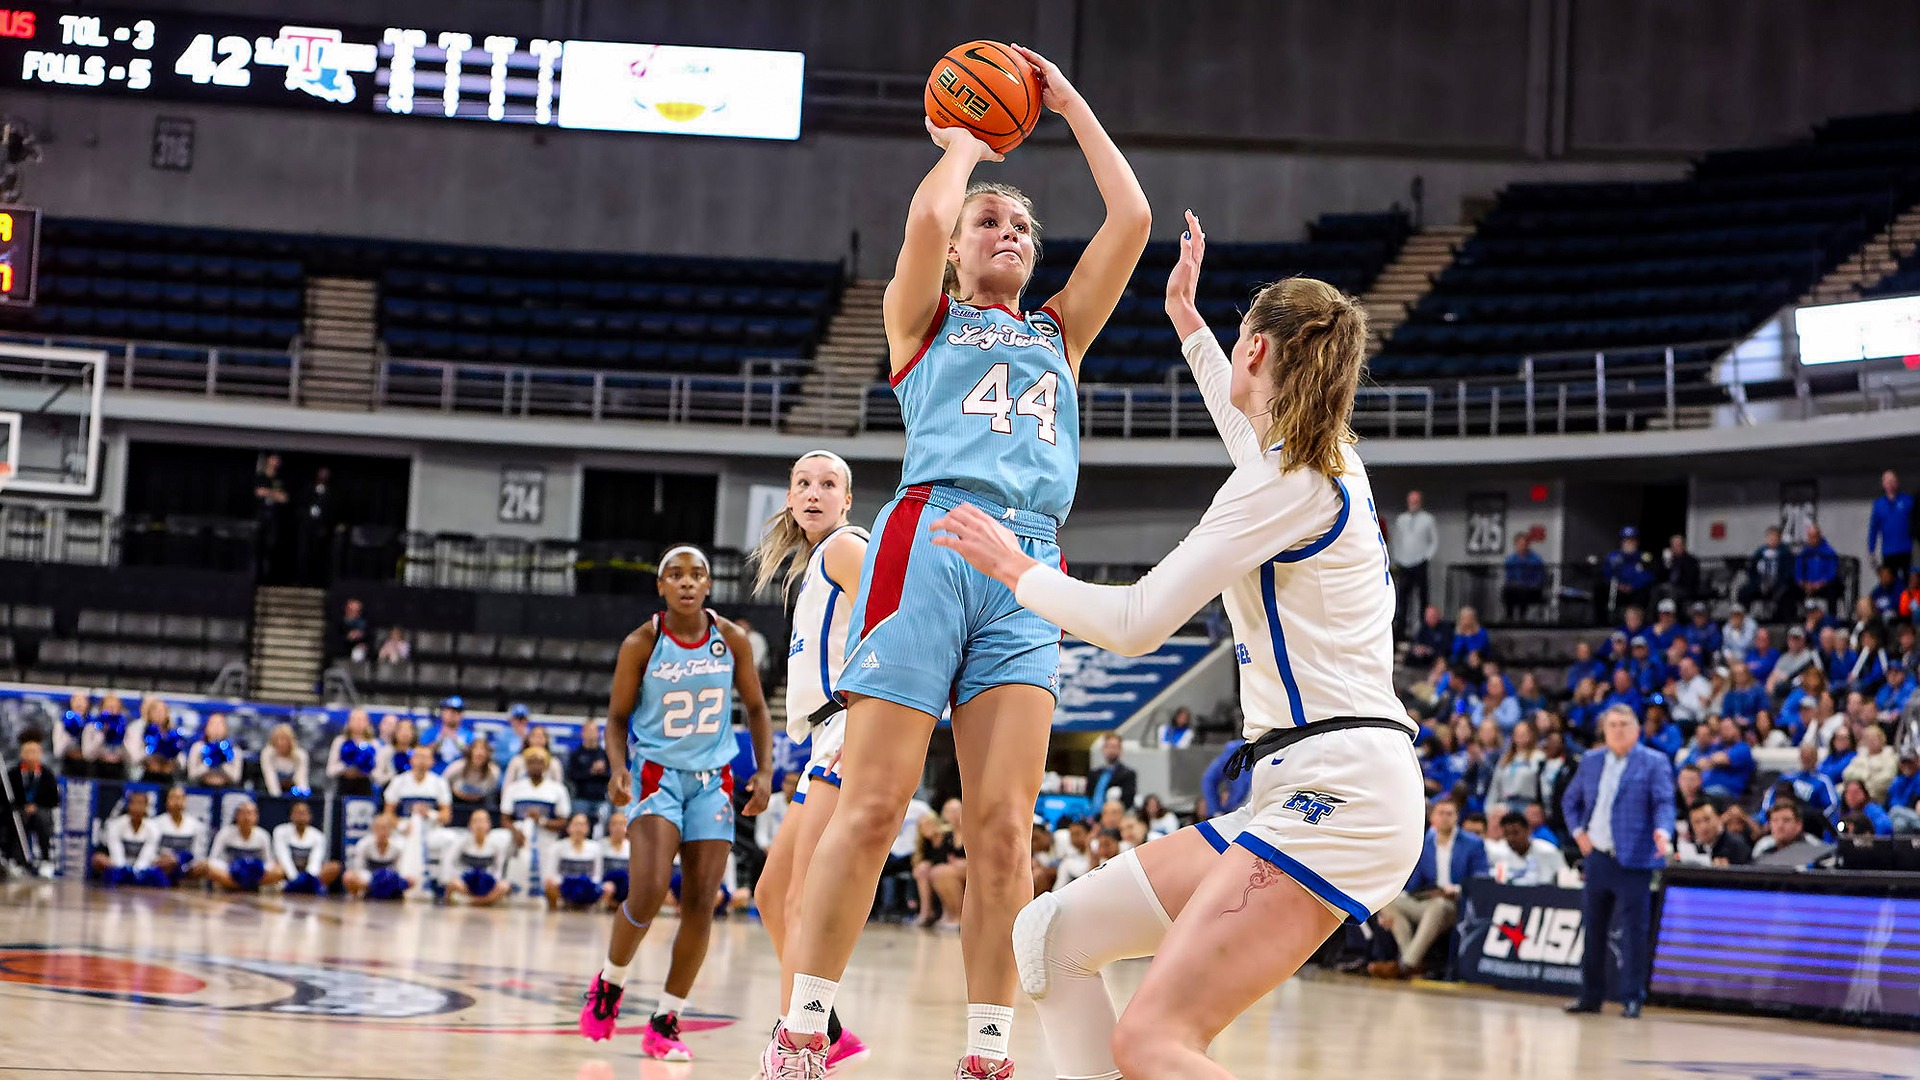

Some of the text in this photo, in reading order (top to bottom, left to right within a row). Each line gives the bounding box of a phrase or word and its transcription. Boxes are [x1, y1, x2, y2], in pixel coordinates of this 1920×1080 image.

[59, 15, 109, 47] TOL
[132, 20, 155, 50] 3
[22, 51, 106, 86] FOULS
[127, 58, 152, 90] 5
[174, 33, 252, 87] 42
[936, 65, 991, 119] ELITE
[947, 323, 998, 352] Lady
[962, 362, 1060, 446] 44
[501, 482, 541, 520] 214
[651, 661, 684, 684] Lady
[661, 687, 725, 739] 22
[1282, 791, 1336, 825] MT
